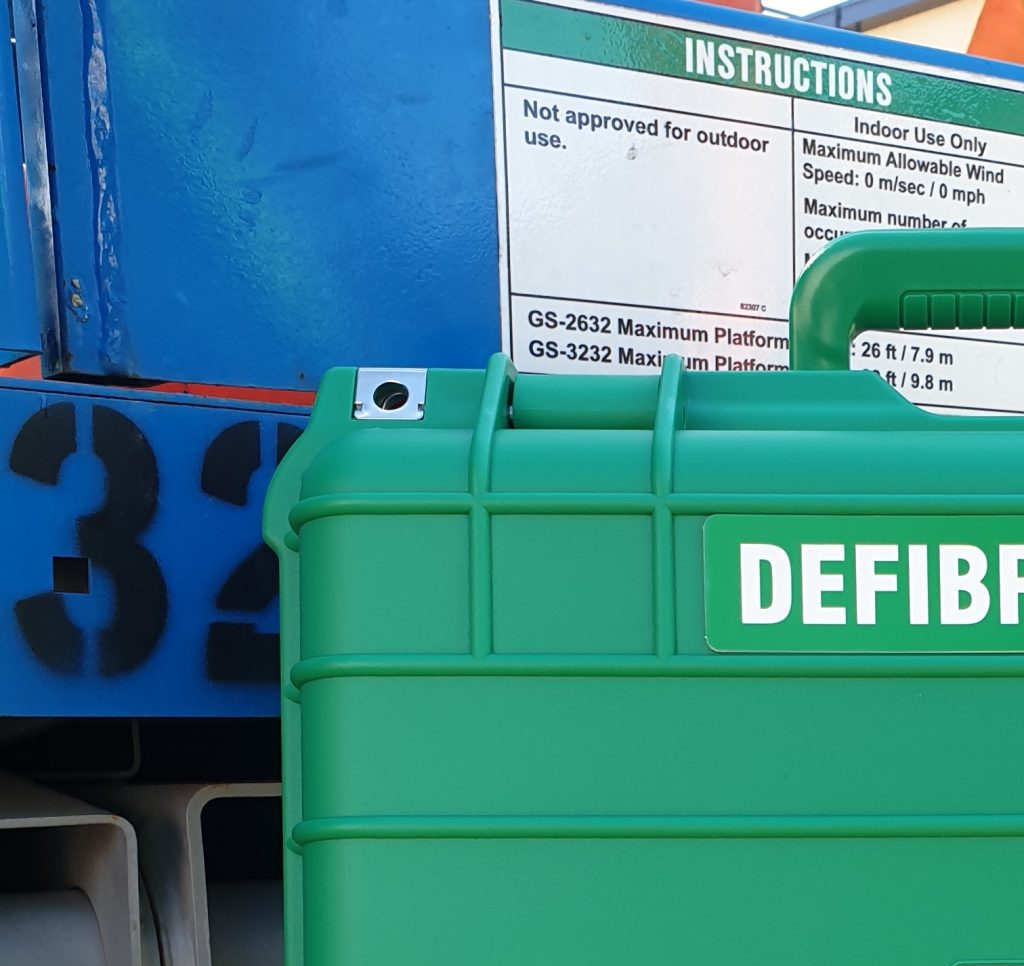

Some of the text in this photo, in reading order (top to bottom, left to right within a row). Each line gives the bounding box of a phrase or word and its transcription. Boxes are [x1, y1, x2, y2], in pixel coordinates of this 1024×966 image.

[685, 37, 892, 106] INSTRUCTIONS
[523, 99, 769, 152] Not approved for outdoor
[524, 129, 567, 150] use.
[854, 116, 987, 157] Indoor Use Only
[803, 137, 1004, 184] Maximum Allowable Wind
[803, 162, 985, 206] Speed: 0 m/sec / 0 mph
[803, 197, 882, 224] Maximum
[887, 211, 947, 228] number
[527, 309, 611, 335] GS-2632
[617, 317, 708, 343] Maximum
[714, 326, 789, 350] Platform
[861, 341, 881, 358] 26
[885, 343, 897, 360] ft
[901, 345, 906, 361] /
[911, 346, 934, 363] 7.9
[939, 352, 953, 365] m
[528, 339, 612, 364] GS-3232
[618, 347, 708, 371] Maxium
[885, 370, 897, 387] ft
[901, 372, 906, 388] /
[911, 373, 934, 390] 9.8
[939, 378, 953, 392] m
